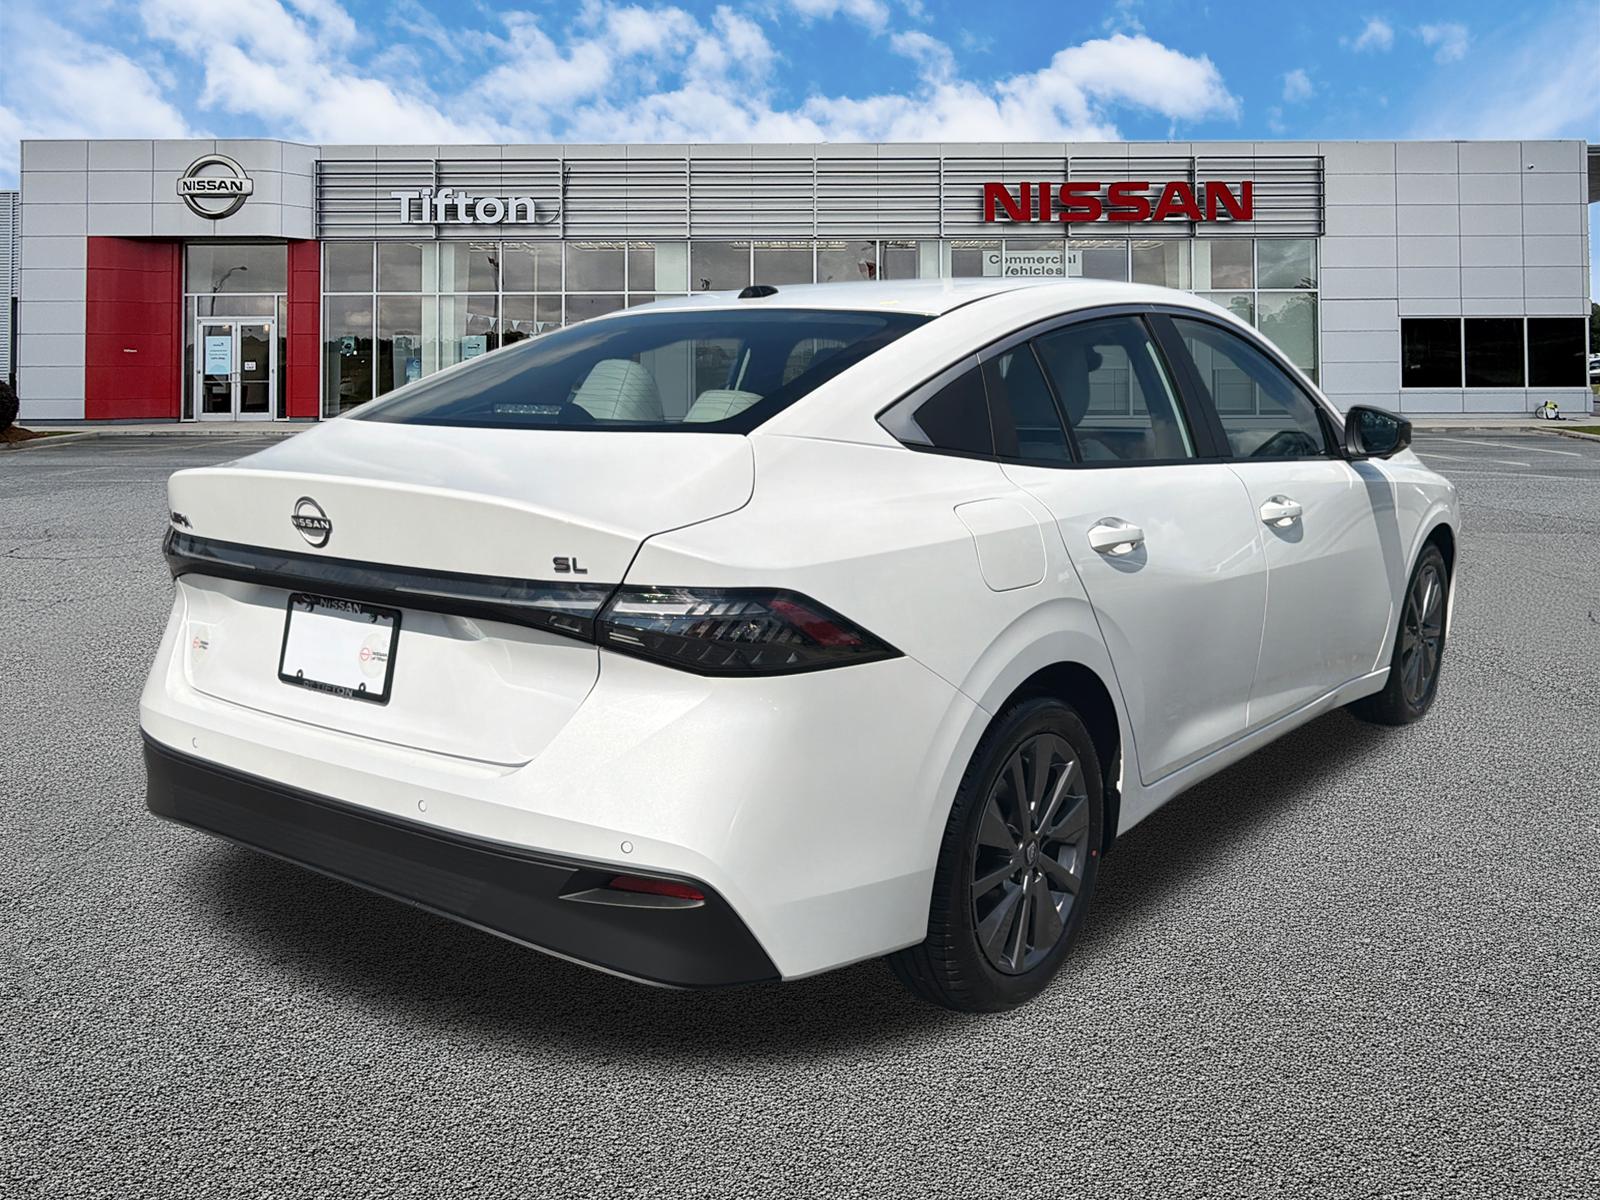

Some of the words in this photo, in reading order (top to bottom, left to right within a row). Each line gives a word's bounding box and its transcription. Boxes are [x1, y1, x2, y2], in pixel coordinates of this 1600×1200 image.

[182, 180, 243, 192] NISSAN
[391, 188, 536, 224] Tifton
[983, 181, 1253, 222] NISSAN
[552, 556, 588, 575] SL
[319, 598, 362, 614] NISSAN
